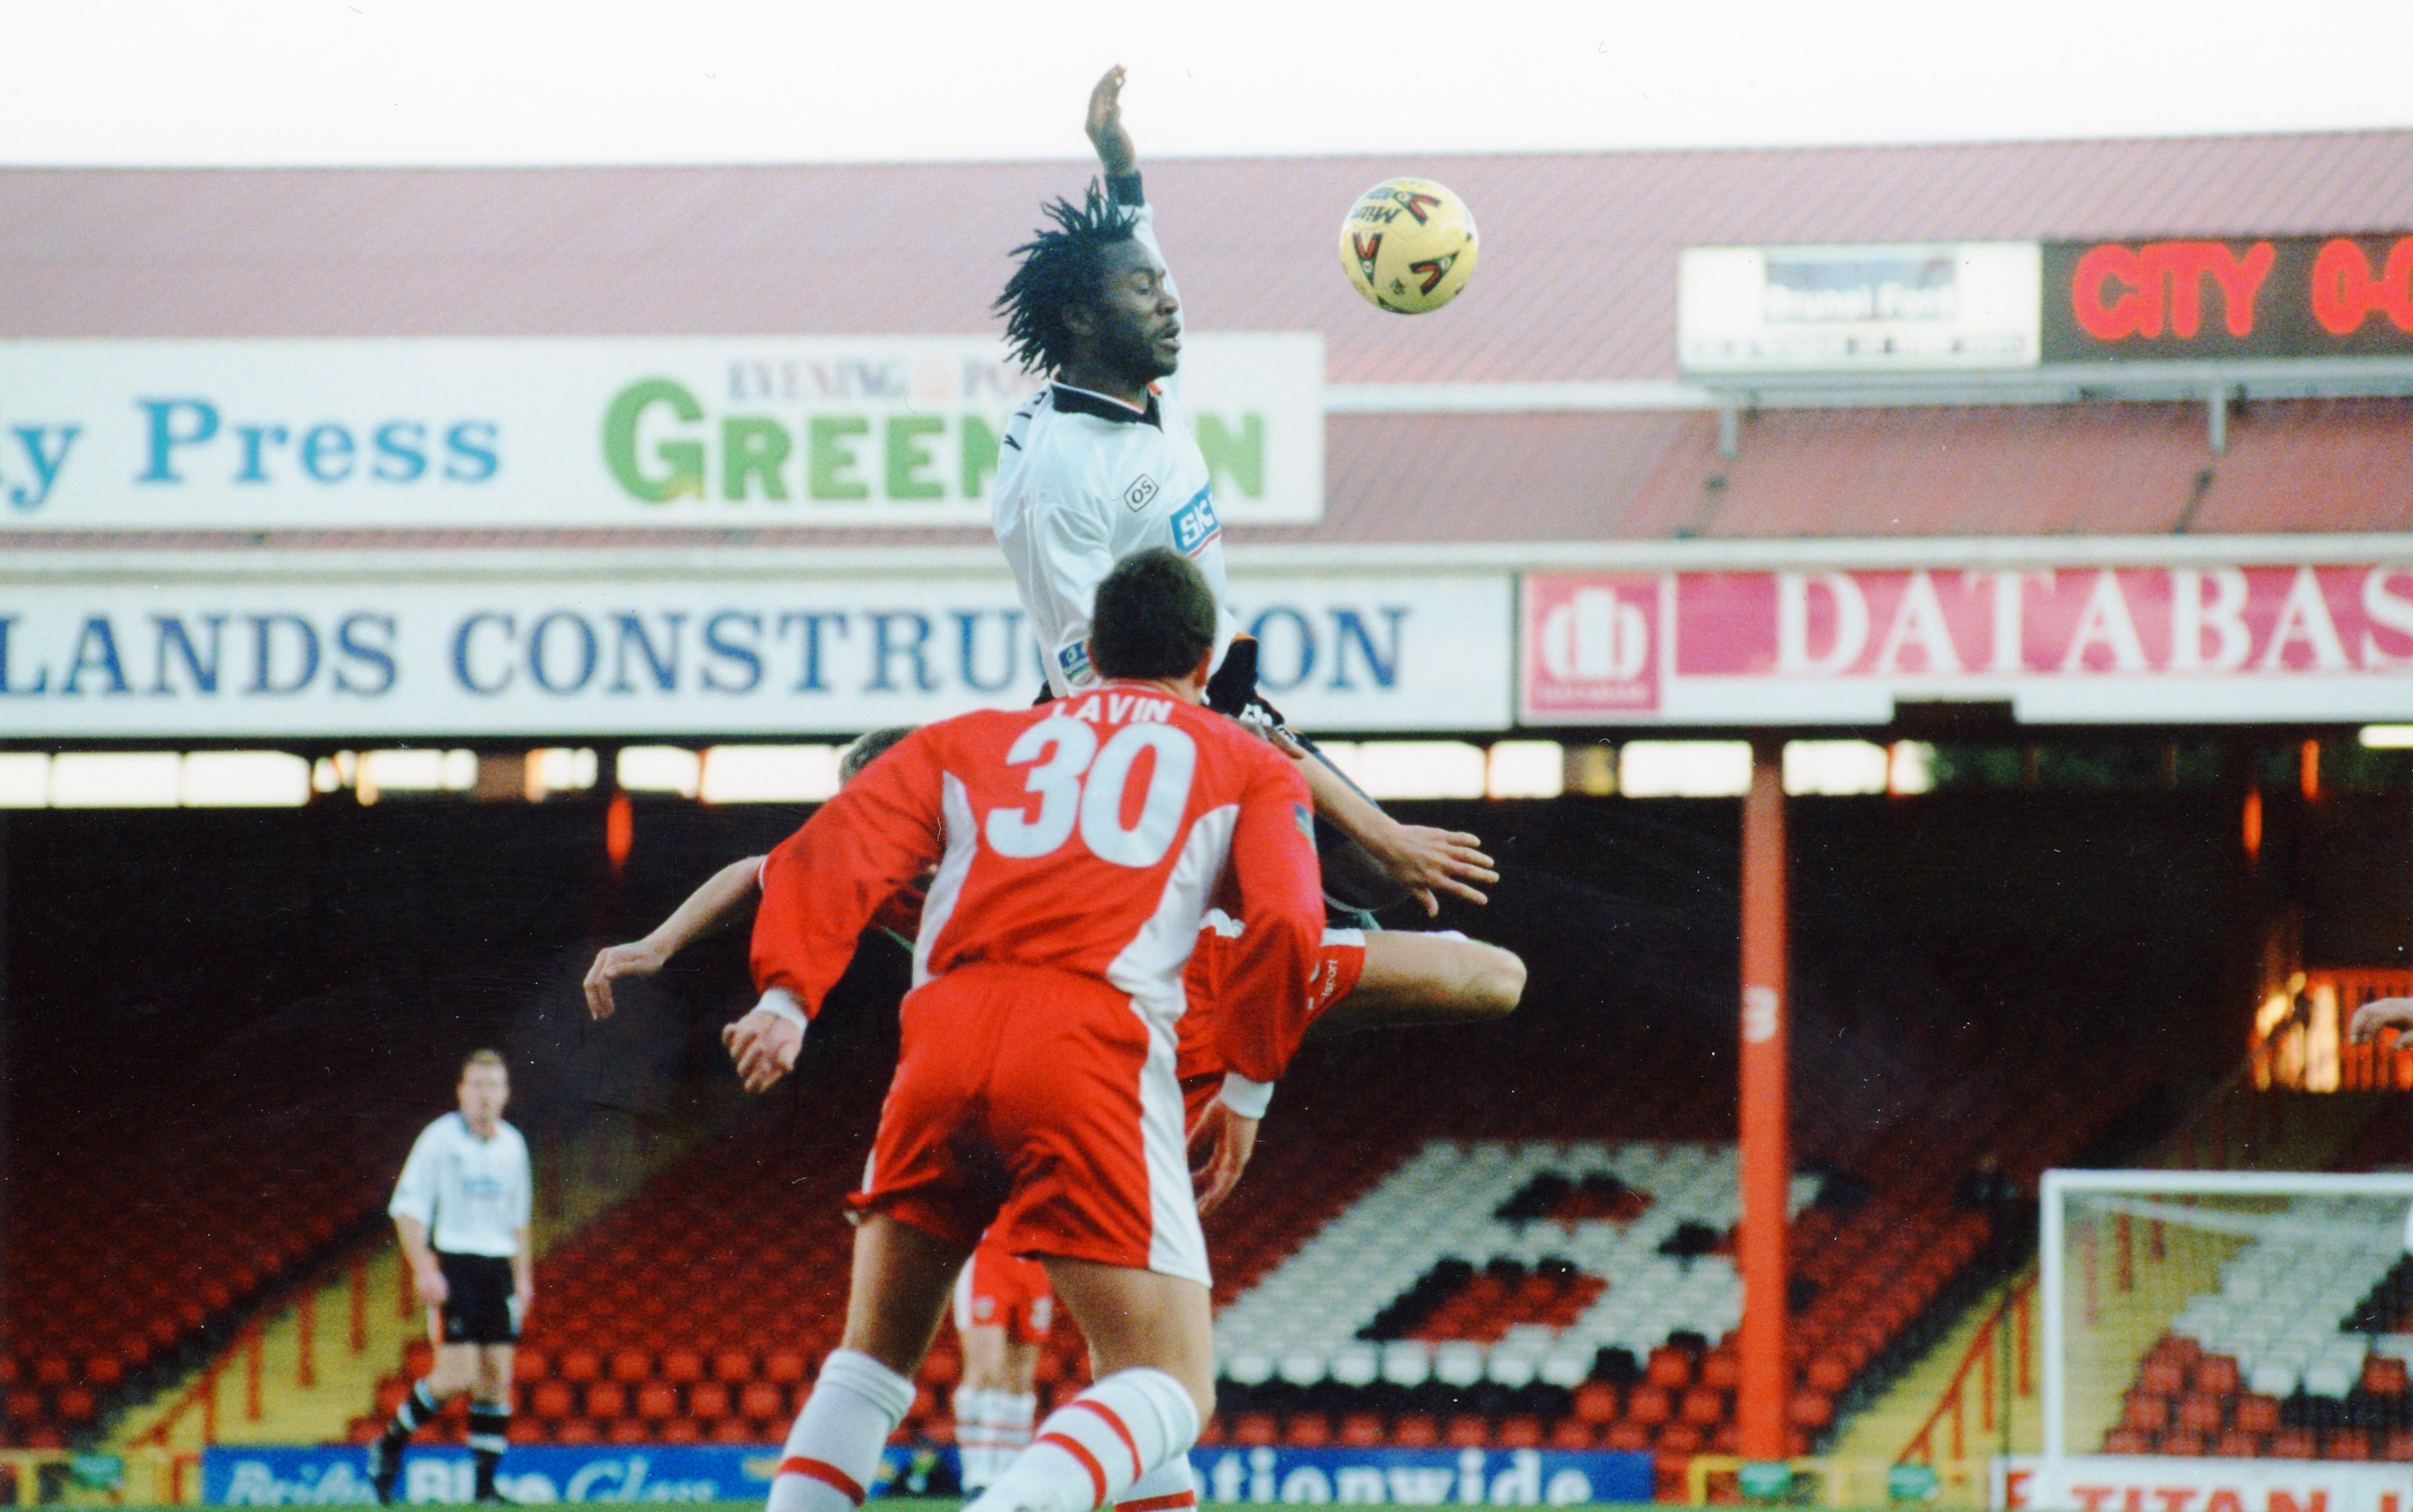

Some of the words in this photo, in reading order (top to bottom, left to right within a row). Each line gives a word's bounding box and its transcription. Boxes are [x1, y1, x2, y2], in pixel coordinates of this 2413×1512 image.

[2071, 240, 2275, 340] CITY
[8, 425, 84, 511] y
[134, 398, 500, 484] Press
[1131, 480, 1152, 503] OS
[1179, 496, 1217, 547] SK
[0, 611, 399, 696] LANDS
[449, 605, 1410, 697] CONSTRUON
[1052, 693, 1174, 724] LAVIN
[987, 715, 1197, 869] 30
[1193, 1447, 1592, 1503] tionwide
